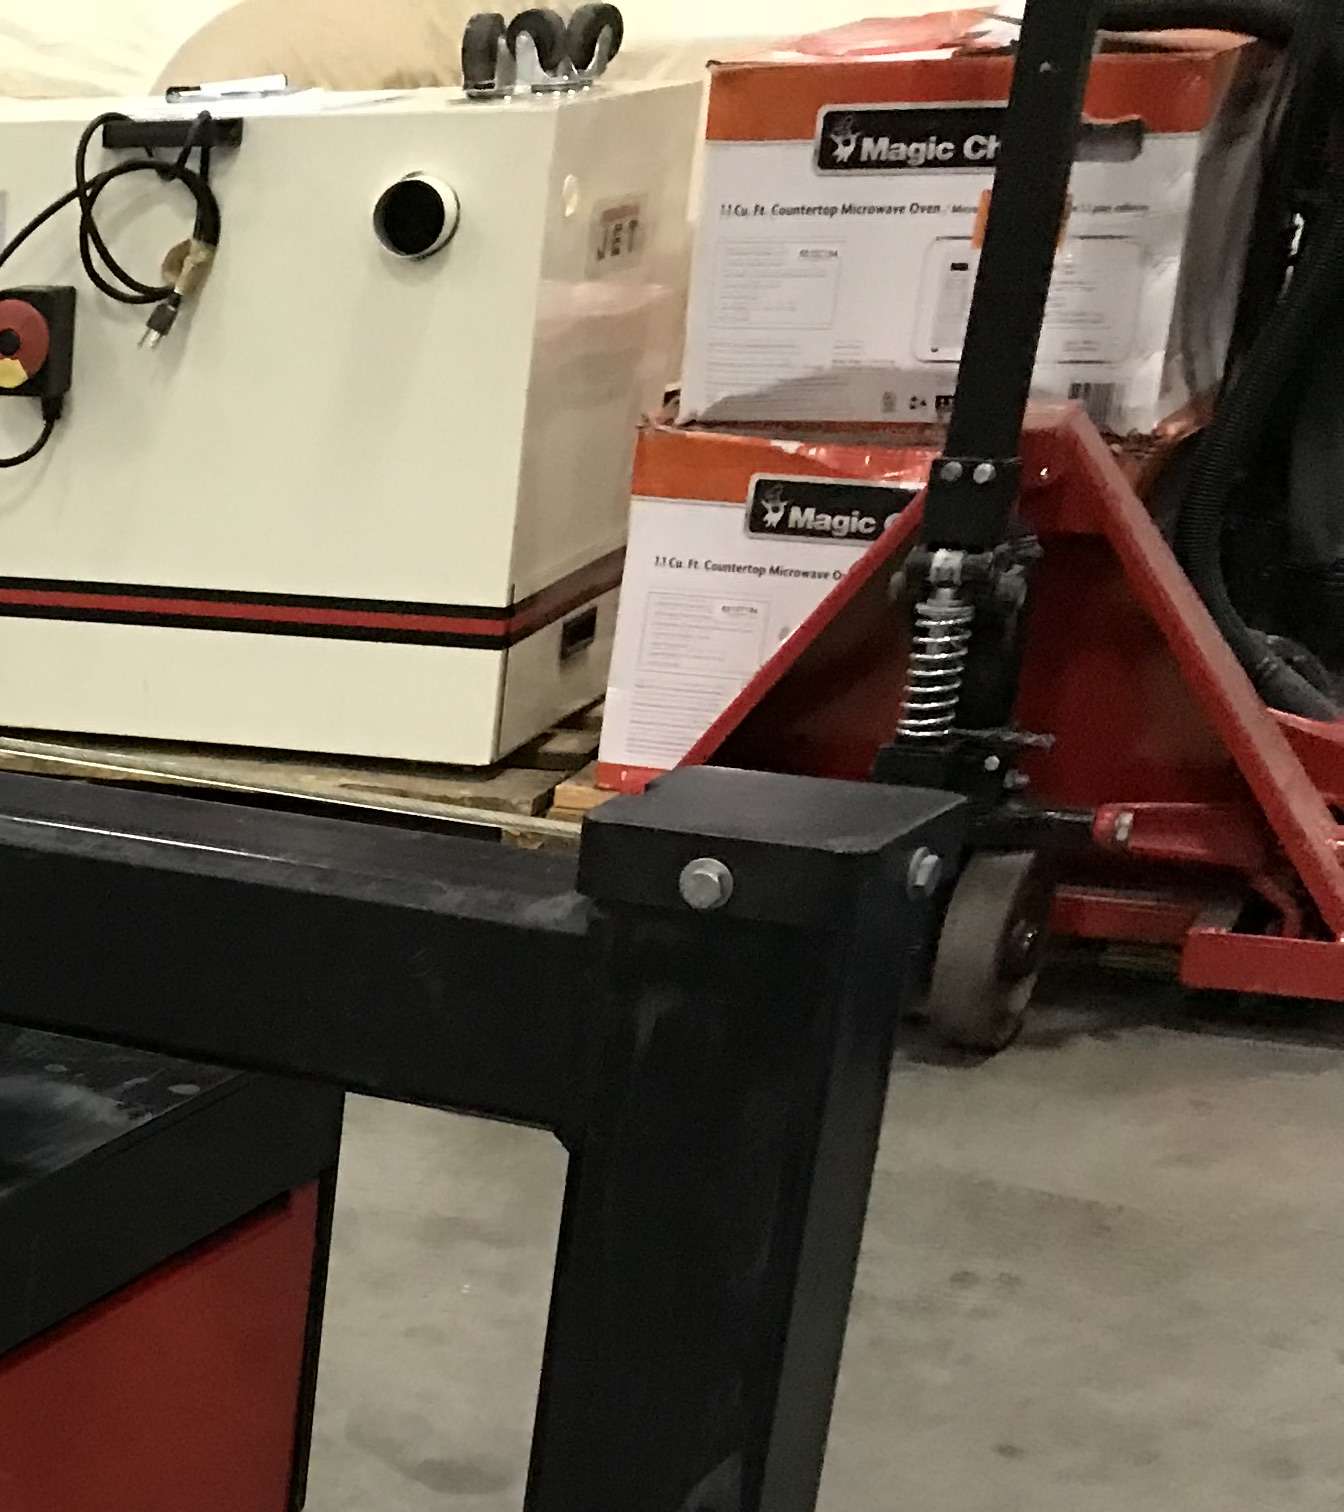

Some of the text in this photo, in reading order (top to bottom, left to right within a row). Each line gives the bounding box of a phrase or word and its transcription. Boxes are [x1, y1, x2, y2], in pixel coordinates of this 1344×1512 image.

[860, 135, 955, 166] Magic
[771, 203, 838, 219] Countertop
[841, 202, 906, 216] Microwave
[909, 202, 941, 214] Oven
[596, 219, 639, 261] JET
[787, 506, 876, 537] Magic
[704, 559, 766, 577] Countertop
[769, 565, 830, 580] Microwave
